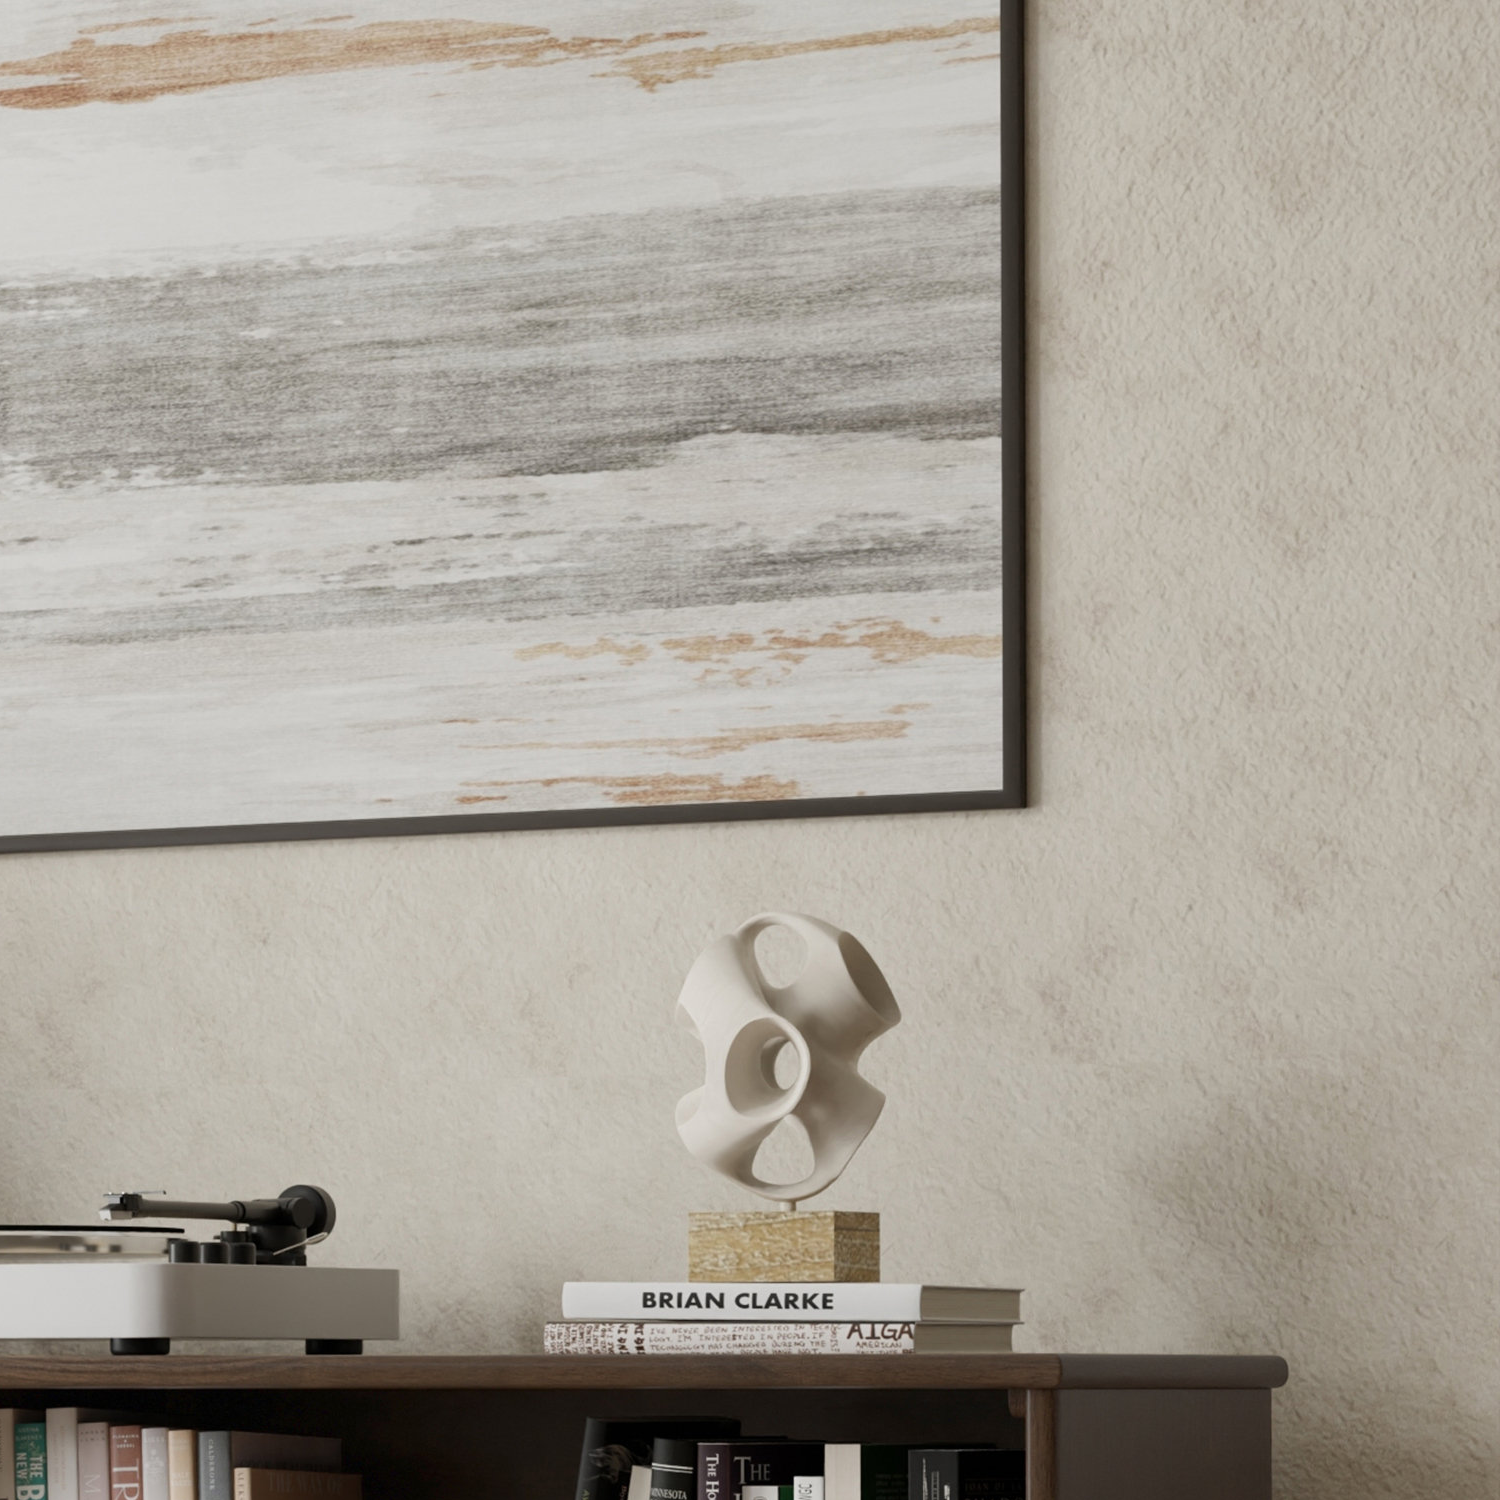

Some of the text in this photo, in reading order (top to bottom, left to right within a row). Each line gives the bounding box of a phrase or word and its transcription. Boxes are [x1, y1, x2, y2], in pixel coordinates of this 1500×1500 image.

[642, 1292, 834, 1310] BRIAN CLARKE
[846, 1323, 914, 1341] AIGA
[15, 1452, 28, 1480] NEW
[29, 1453, 44, 1479] THE
[705, 1454, 719, 1477] THE
[733, 1455, 771, 1485] THE
